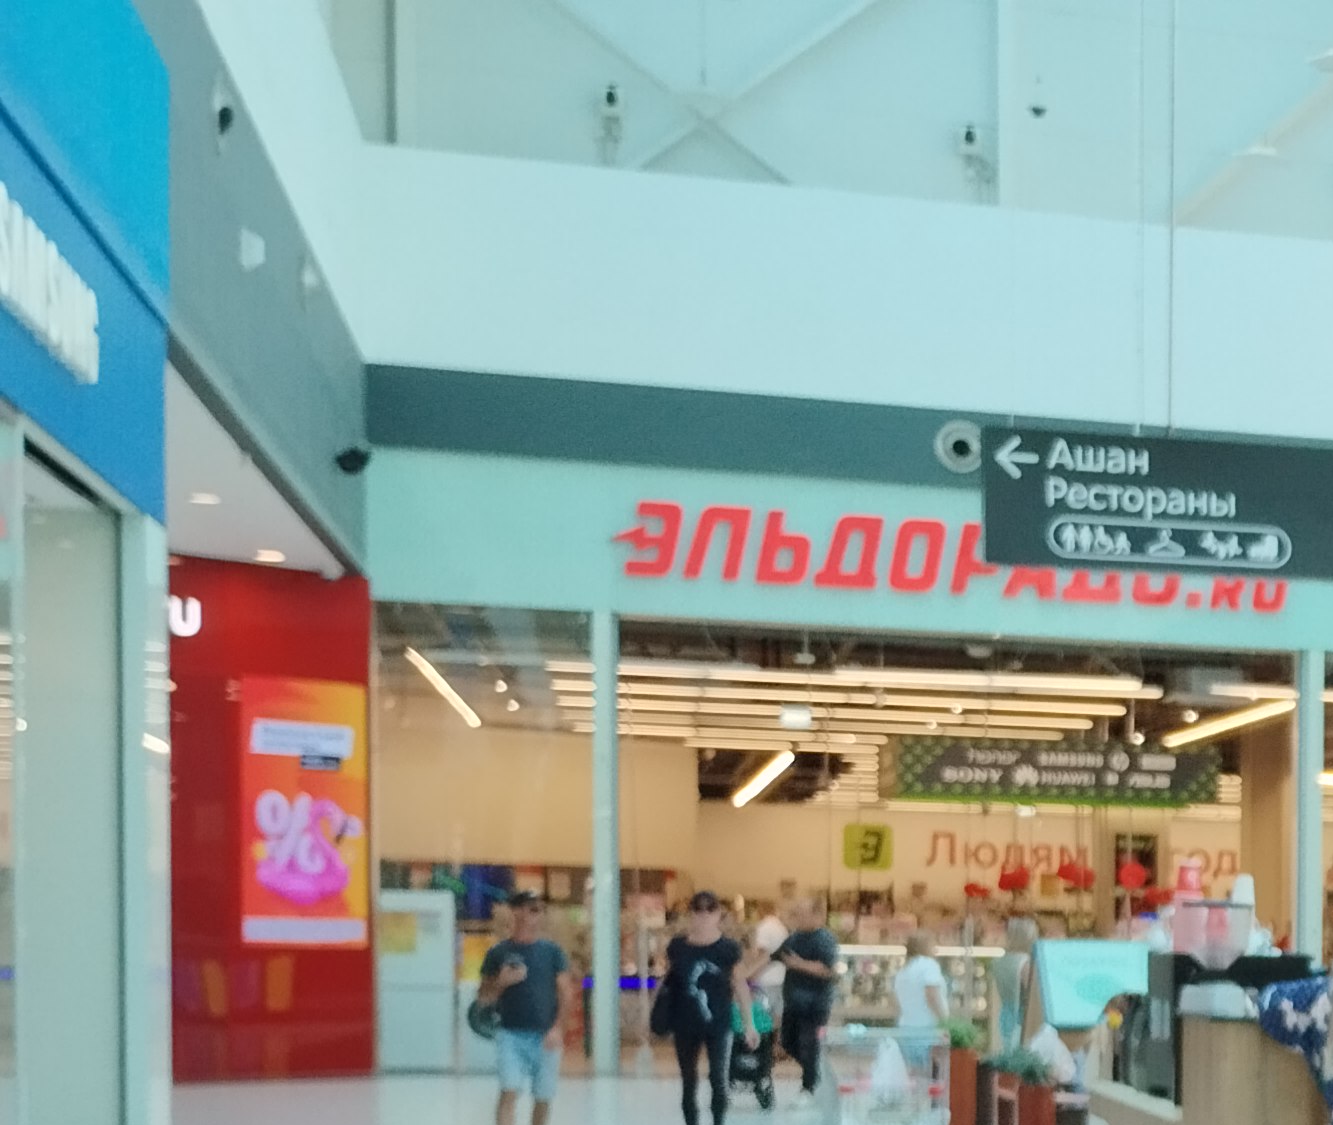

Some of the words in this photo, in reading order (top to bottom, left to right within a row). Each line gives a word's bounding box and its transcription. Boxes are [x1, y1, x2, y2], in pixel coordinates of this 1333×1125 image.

[1046, 437, 1149, 476] Ашан
[1045, 475, 1236, 520] Рестораны
[940, 766, 1003, 784] SONY
